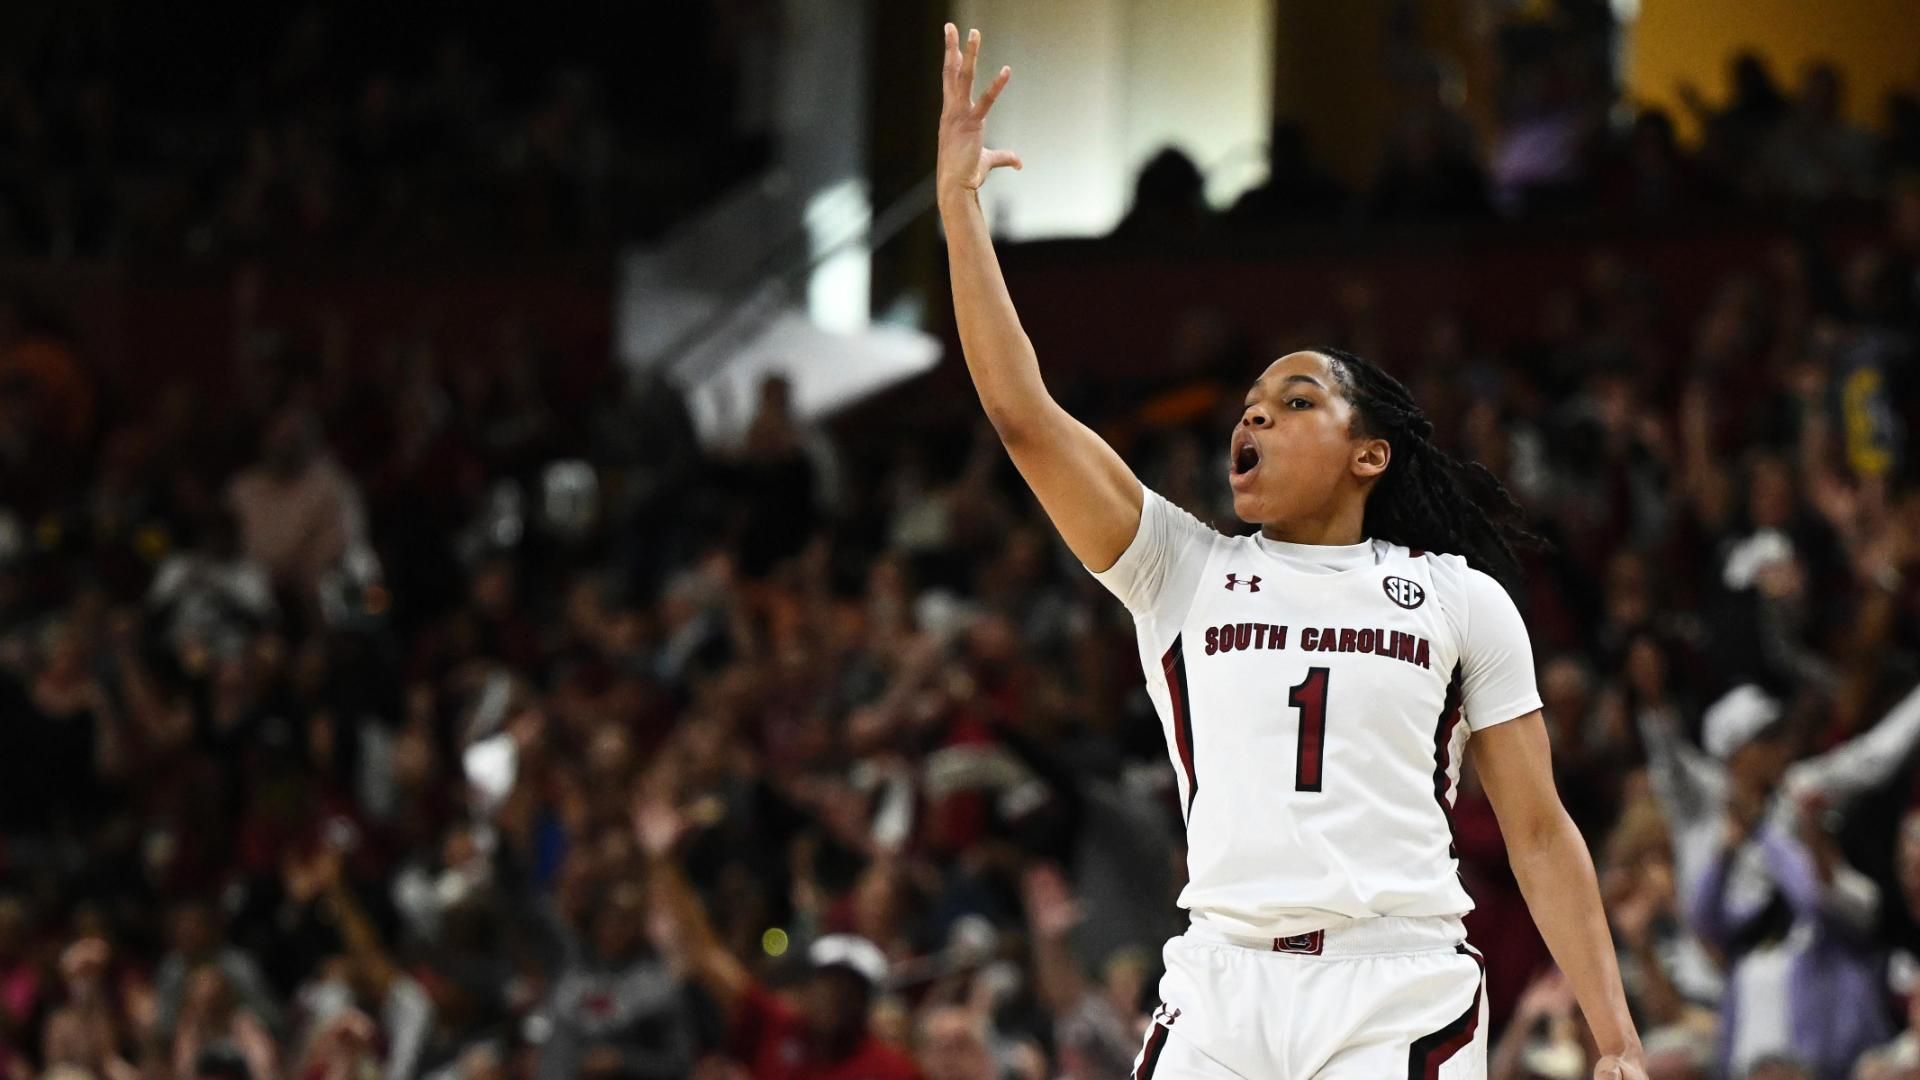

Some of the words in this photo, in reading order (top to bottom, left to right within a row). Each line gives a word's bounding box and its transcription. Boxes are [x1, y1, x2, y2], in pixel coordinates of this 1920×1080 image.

[1386, 577, 1422, 607] SEC
[1205, 622, 1288, 656] SOUTH
[1301, 627, 1430, 669] CAROLINA
[1288, 666, 1330, 792] 1
